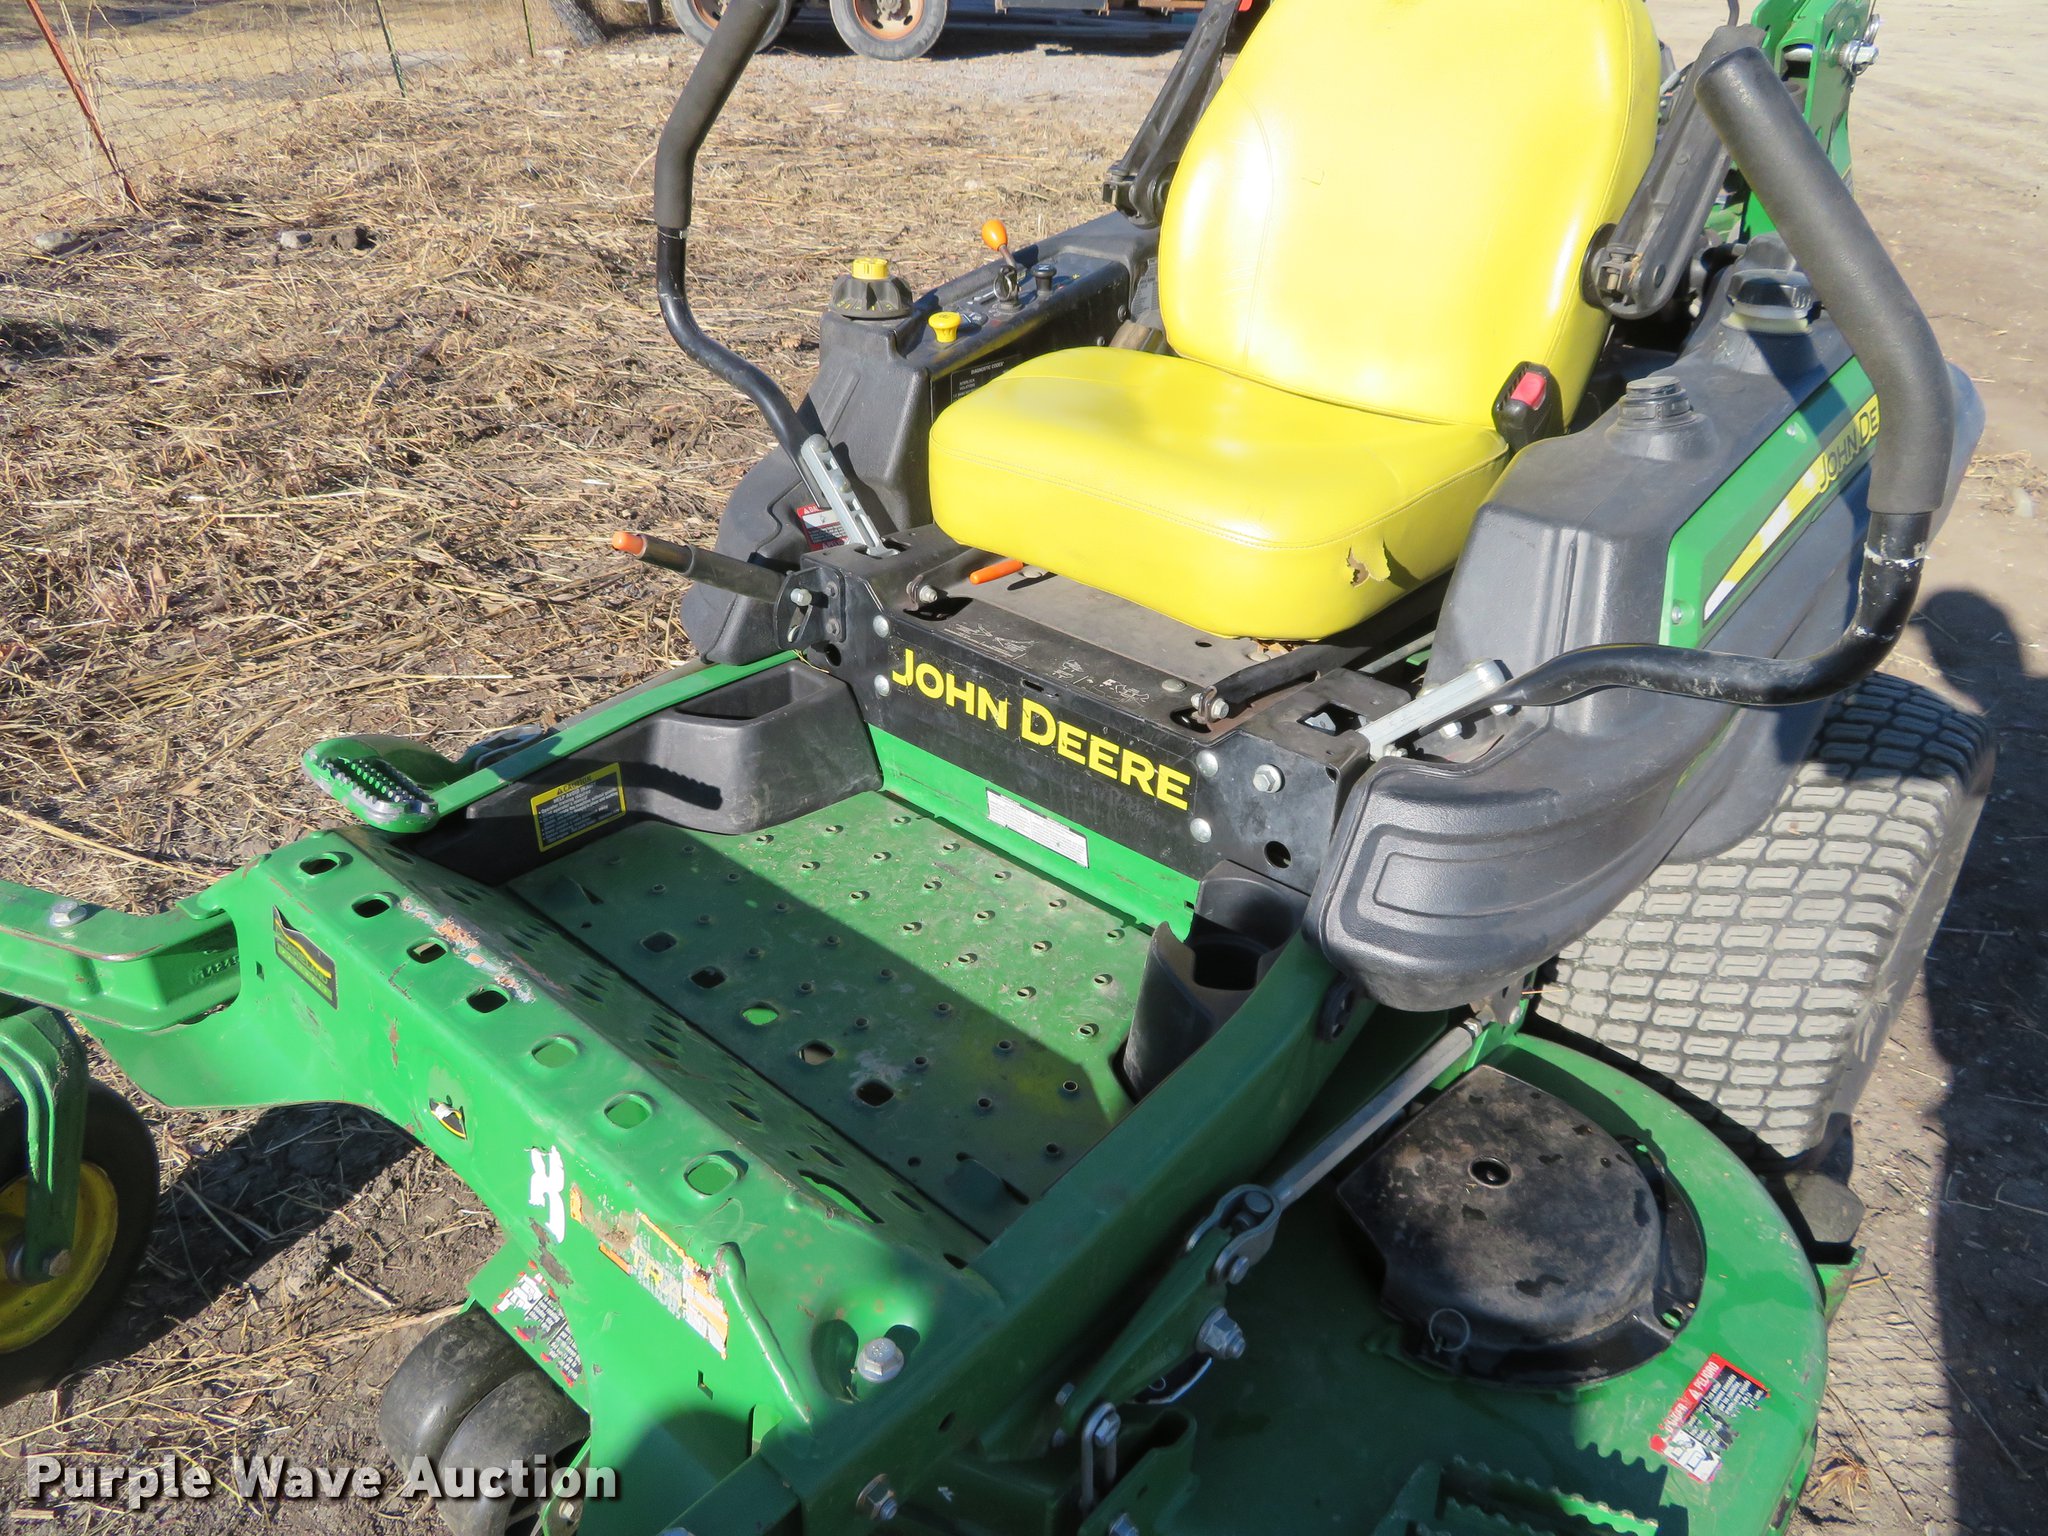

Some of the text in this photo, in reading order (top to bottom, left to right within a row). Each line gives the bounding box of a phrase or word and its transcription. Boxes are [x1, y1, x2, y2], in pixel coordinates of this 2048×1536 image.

[1819, 434, 1858, 491] JOHN
[892, 648, 1192, 812] JOHN DEERE
[1693, 1361, 1720, 1391] PELIGRO
